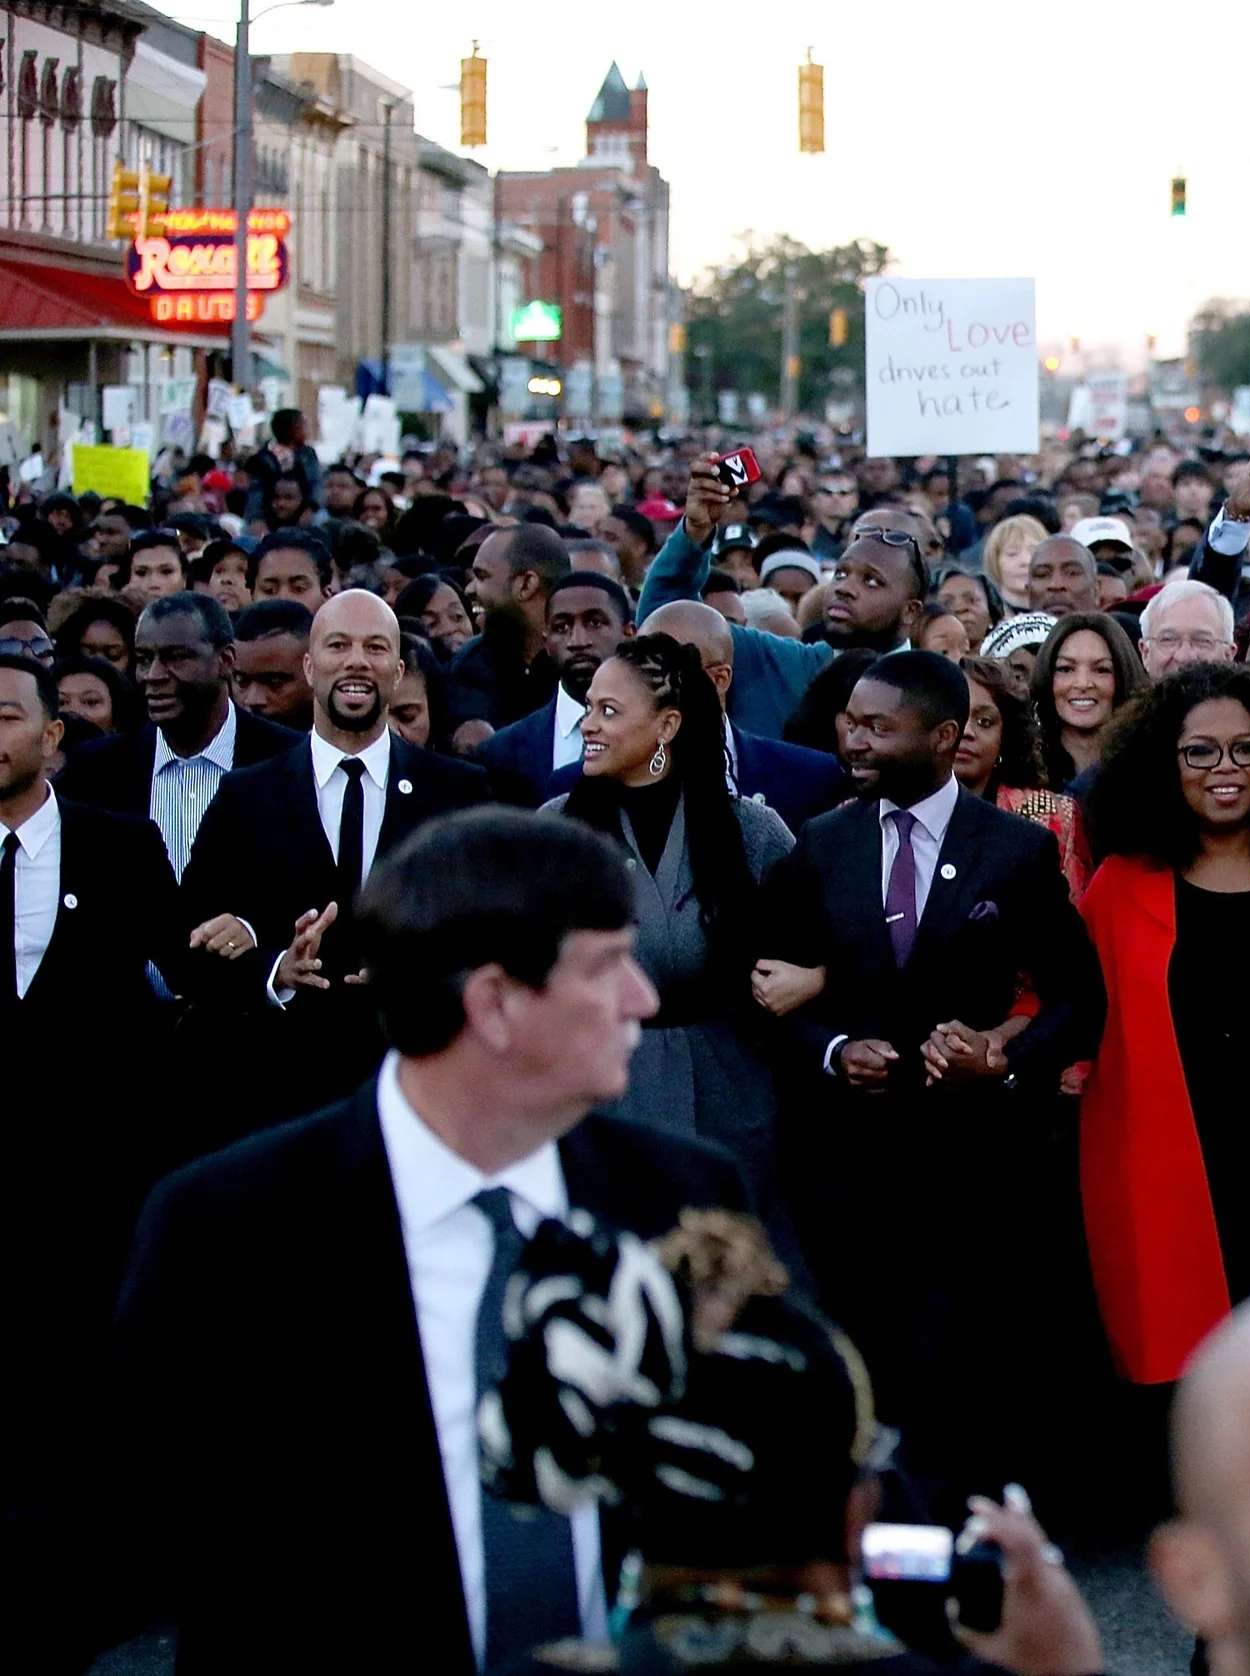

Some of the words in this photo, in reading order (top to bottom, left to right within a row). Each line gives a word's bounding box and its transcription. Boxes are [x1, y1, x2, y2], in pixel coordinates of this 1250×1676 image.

[133, 234, 281, 290] Rexall
[875, 282, 943, 332] Only
[879, 354, 950, 385] drives
[960, 357, 1002, 379] out
[917, 386, 1011, 418] hate
